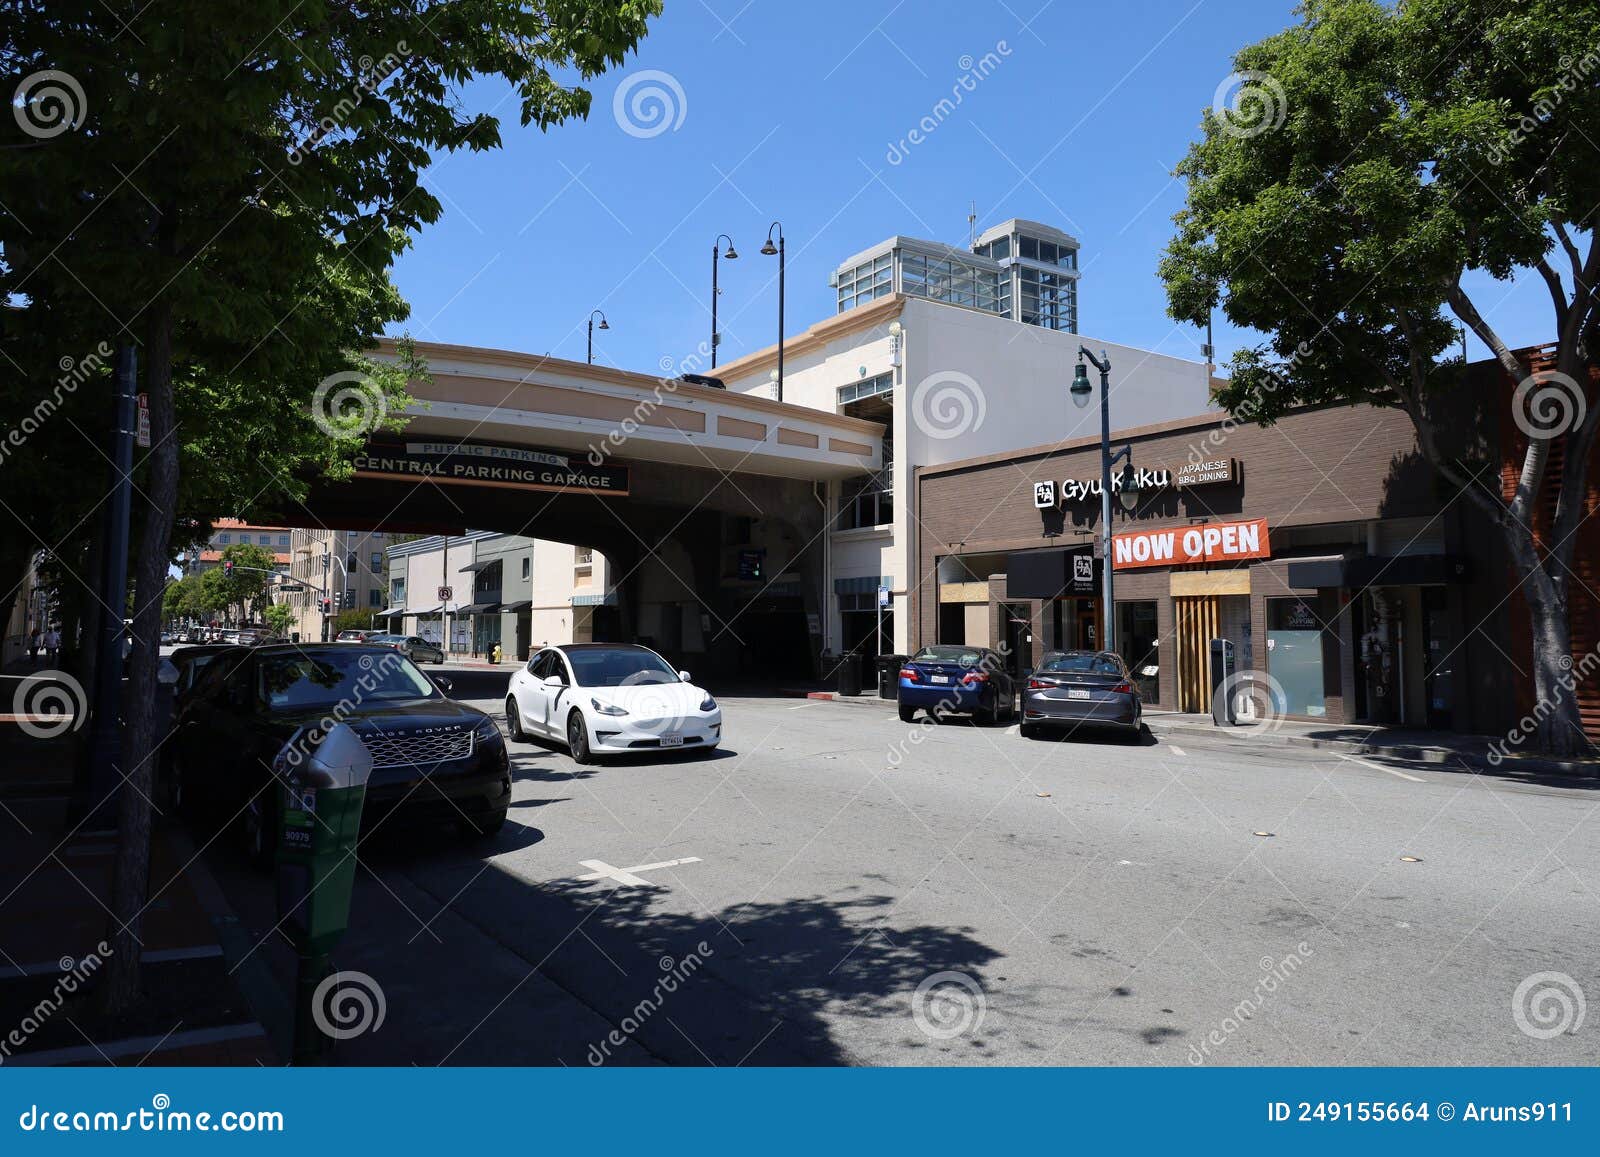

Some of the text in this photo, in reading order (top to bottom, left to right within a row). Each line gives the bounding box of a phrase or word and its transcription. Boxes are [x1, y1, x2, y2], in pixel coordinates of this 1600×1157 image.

[423, 444, 558, 464] PUBLIC PARKING
[353, 456, 611, 487] CENTRAL PARKING GARAGE
[1178, 460, 1228, 475] JAPANESE
[1178, 471, 1228, 485] BBQ DINING
[1115, 532, 1174, 563] NOW
[1182, 524, 1260, 557] OPEN
[415, 725, 461, 734] ROVER
